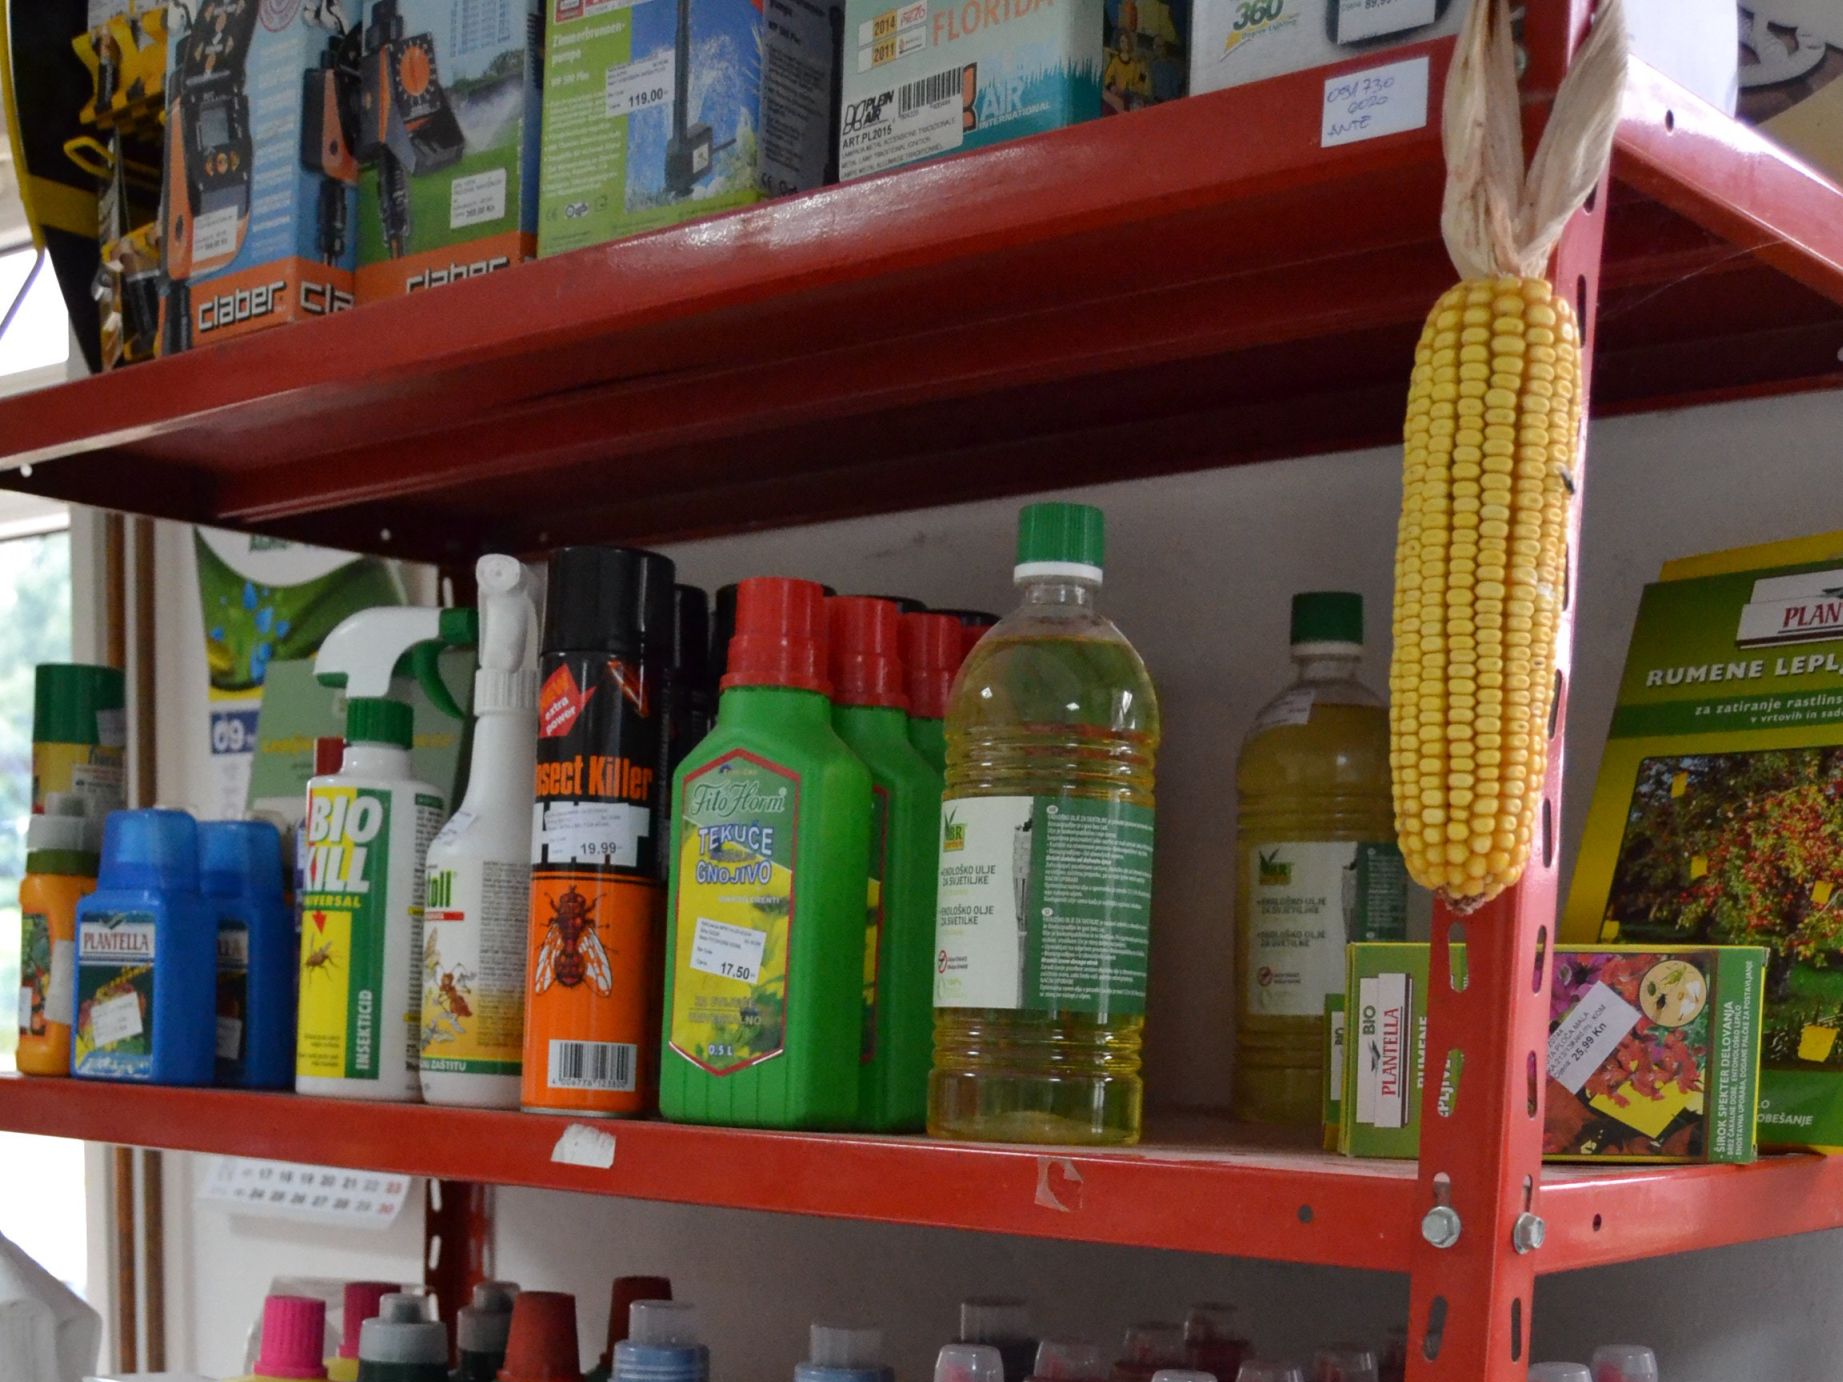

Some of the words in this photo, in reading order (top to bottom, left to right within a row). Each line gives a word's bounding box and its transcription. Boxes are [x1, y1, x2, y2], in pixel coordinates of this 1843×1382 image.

[873, 16, 896, 36] 2014
[873, 42, 896, 63] 2011
[628, 88, 664, 107] 119.00
[198, 280, 288, 332] claber
[1646, 660, 1764, 687] RUMENE
[545, 697, 568, 720] extra
[546, 706, 576, 735] power
[1695, 706, 1711, 716] za
[1716, 698, 1781, 715] zatiranje
[1761, 711, 1802, 723] vrtovih
[1806, 710, 1818, 719] in
[588, 755, 653, 800] Killer
[309, 796, 383, 843] BIO
[580, 842, 617, 855] 19.99
[696, 861, 772, 885] GNOJIVO
[84, 932, 149, 951] PLANTELLA
[721, 962, 750, 980] 17.50
[355, 990, 373, 1071] INSEKTICID
[1362, 1005, 1377, 1035] BIO
[1721, 1001, 1733, 1067] DELOVANJA
[1381, 1007, 1400, 1096] PLANTELLA
[1571, 1035, 1596, 1062] 25,99
[1591, 1021, 1607, 1037] Kn
[1718, 1070, 1729, 1117] SPEKTER
[1716, 1120, 1726, 1152] ŠIROK
